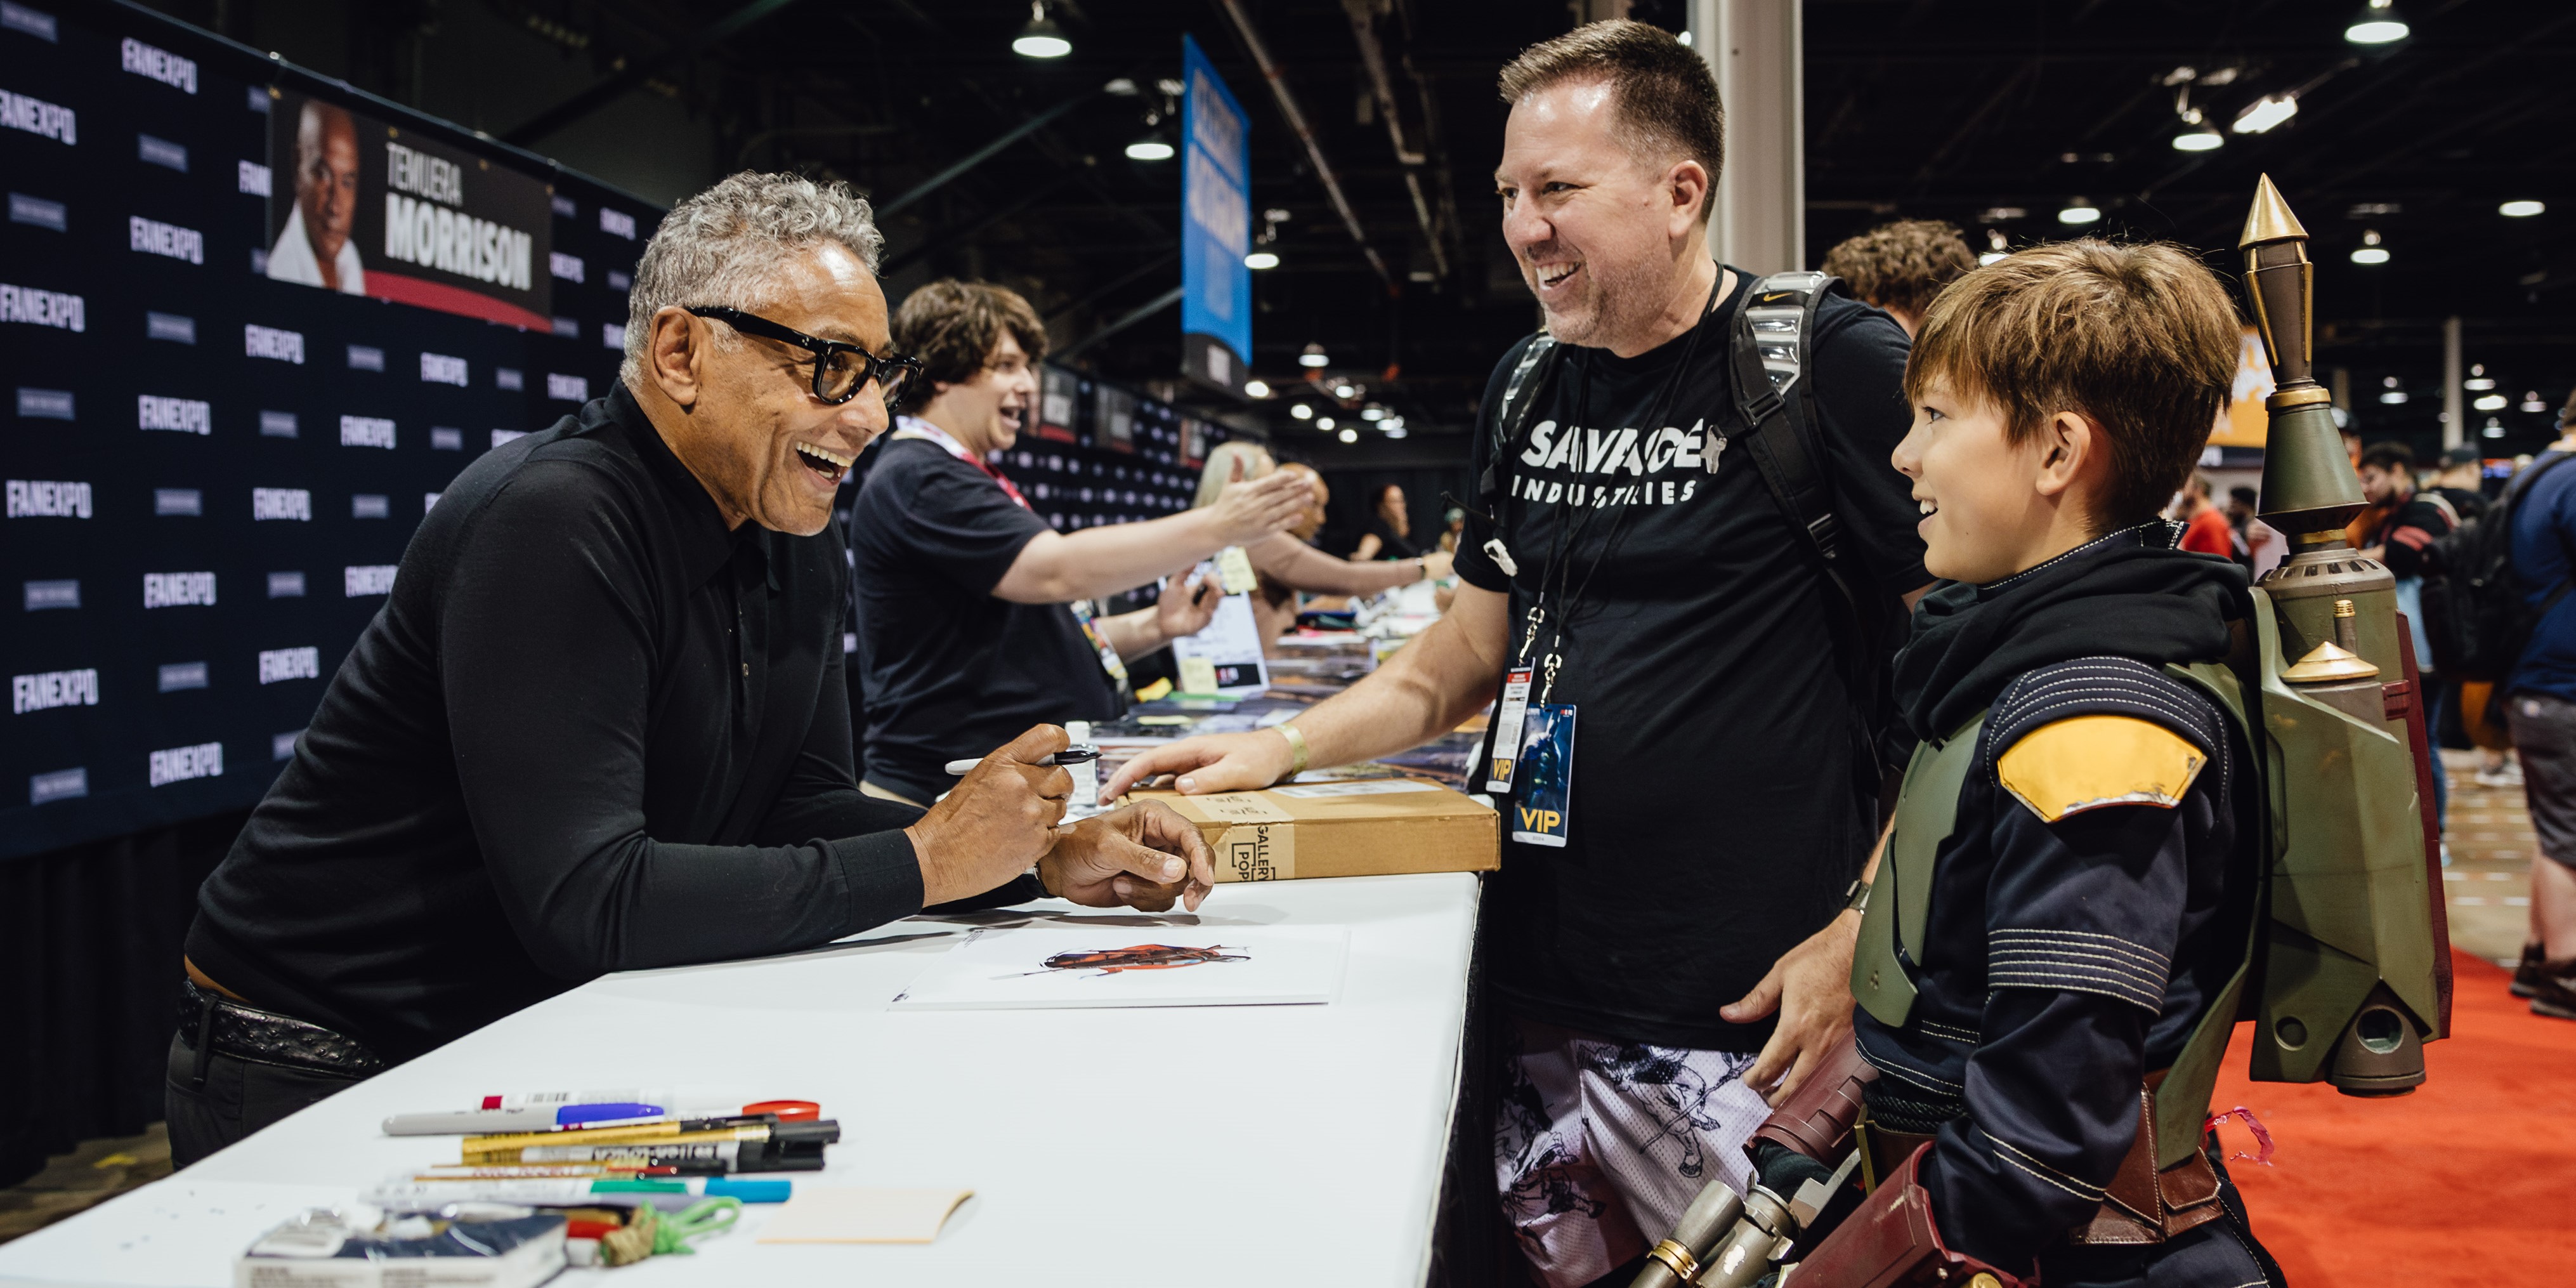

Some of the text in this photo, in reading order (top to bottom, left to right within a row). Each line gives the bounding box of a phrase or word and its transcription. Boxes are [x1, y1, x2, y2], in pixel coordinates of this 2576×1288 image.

[0, 89, 76, 145] ANEXPO
[386, 141, 462, 206] TEMUERA
[385, 192, 532, 291] MORRISON
[1520, 418, 1704, 476] SAVAGE
[1512, 475, 1696, 509] INDUSTRIES
[1493, 758, 1512, 781] VIP
[1520, 806, 1560, 833] VIP
[1258, 825, 1269, 881] GALLERY
